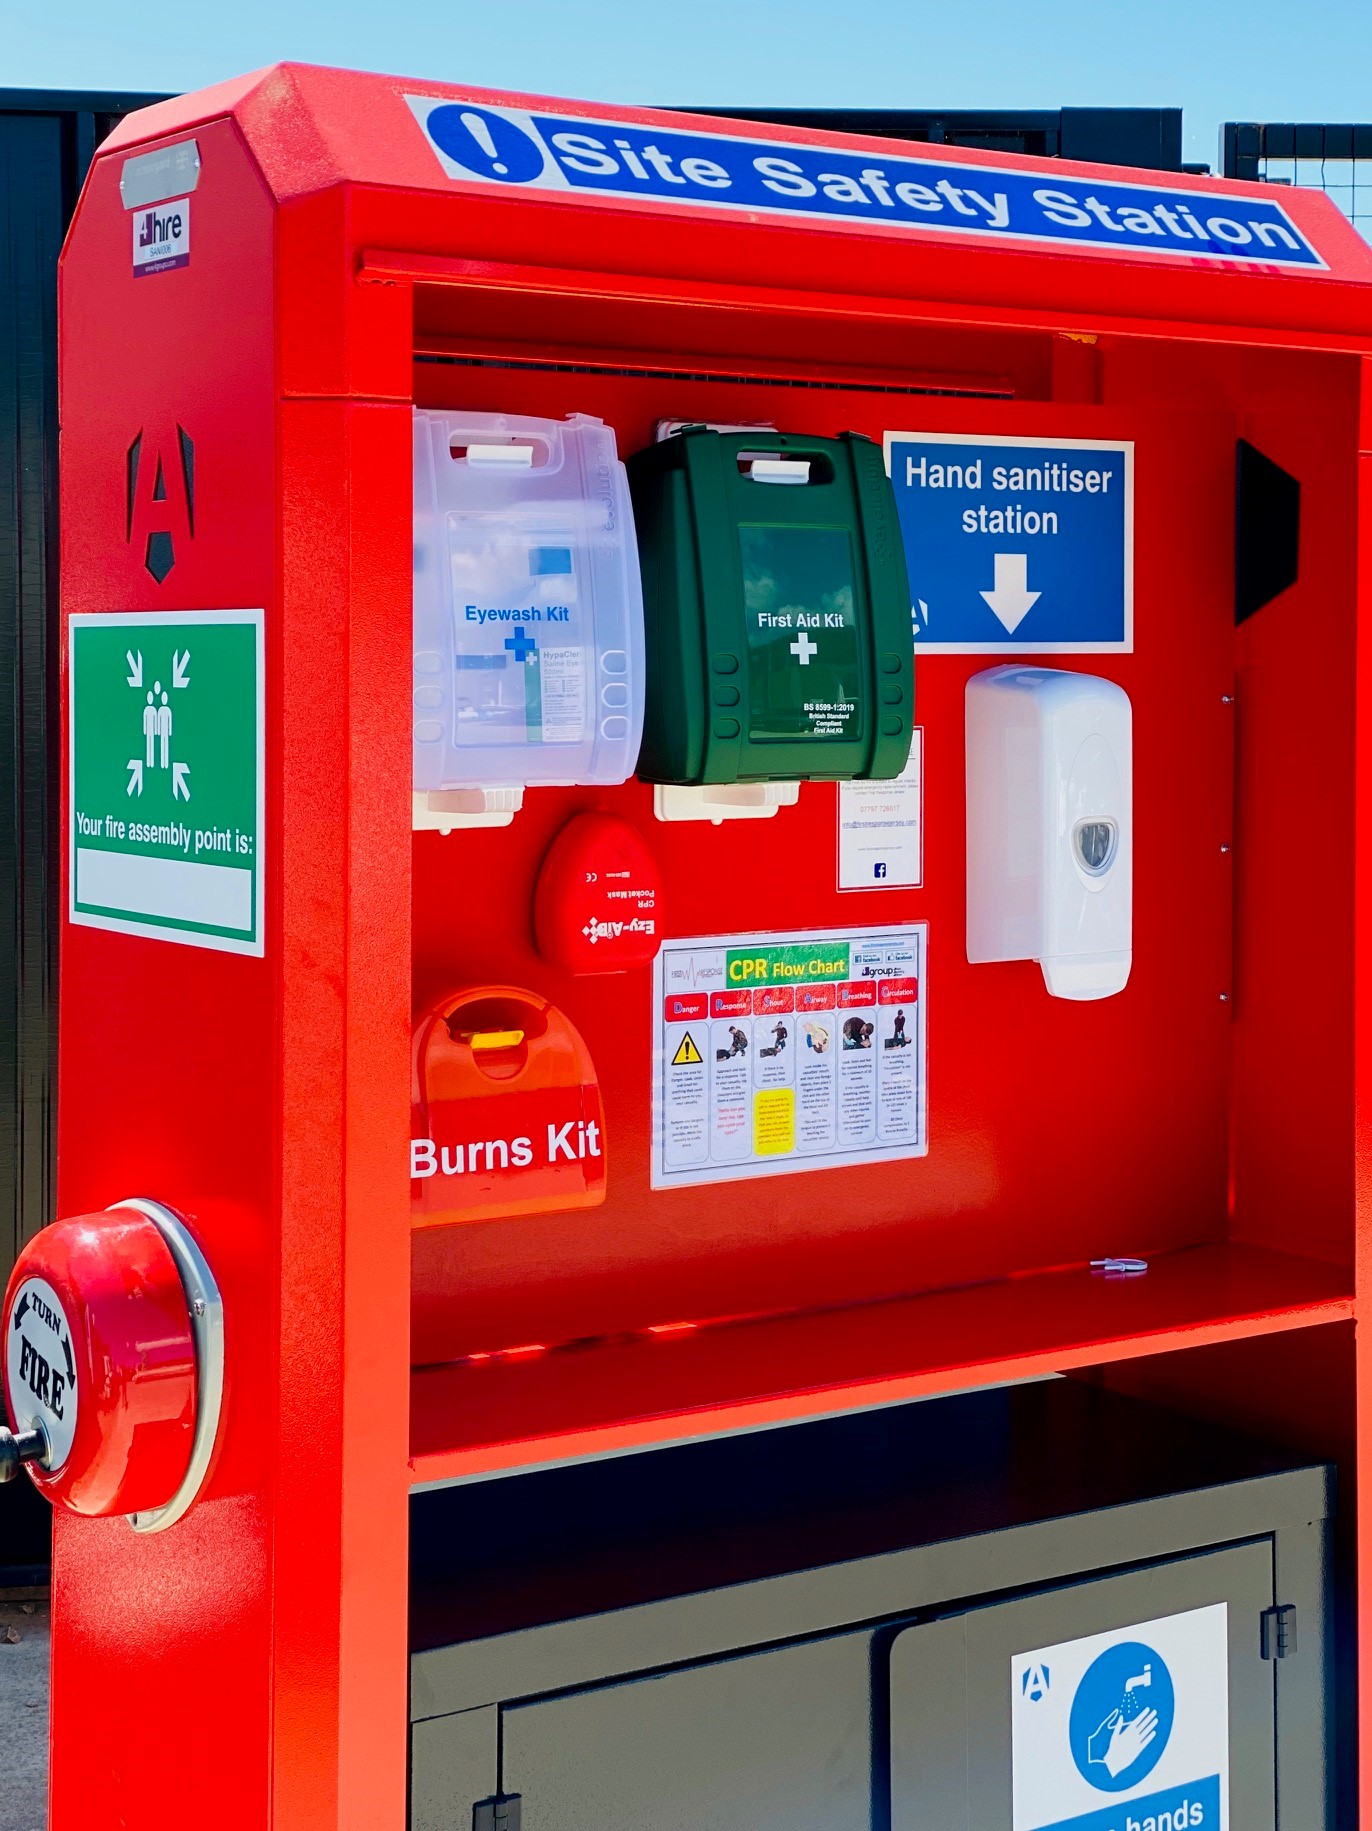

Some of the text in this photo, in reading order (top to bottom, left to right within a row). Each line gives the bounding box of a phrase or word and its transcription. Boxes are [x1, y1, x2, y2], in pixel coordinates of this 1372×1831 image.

[552, 132, 1301, 251] Site Safety Station
[906, 456, 1113, 493] Hand sanitiser
[962, 504, 1058, 535] station
[465, 605, 570, 625] Eyewash Kit
[758, 612, 844, 628] First Aid Kit
[77, 812, 253, 855] Your fire assembly point is:
[606, 890, 655, 898] Pocket Mask
[638, 899, 655, 908] CPR
[729, 958, 846, 981] CPR Flow Chart
[804, 993, 828, 1005] Airway
[842, 989, 872, 1000] Breathing
[881, 986, 914, 998] Circulation
[674, 1002, 700, 1014] Danger
[716, 999, 747, 1010] Response
[764, 996, 784, 1008] Shout
[410, 1120, 601, 1179] Burns Kit
[32, 1291, 62, 1336] TURN
[19, 1334, 65, 1421] FIRE
